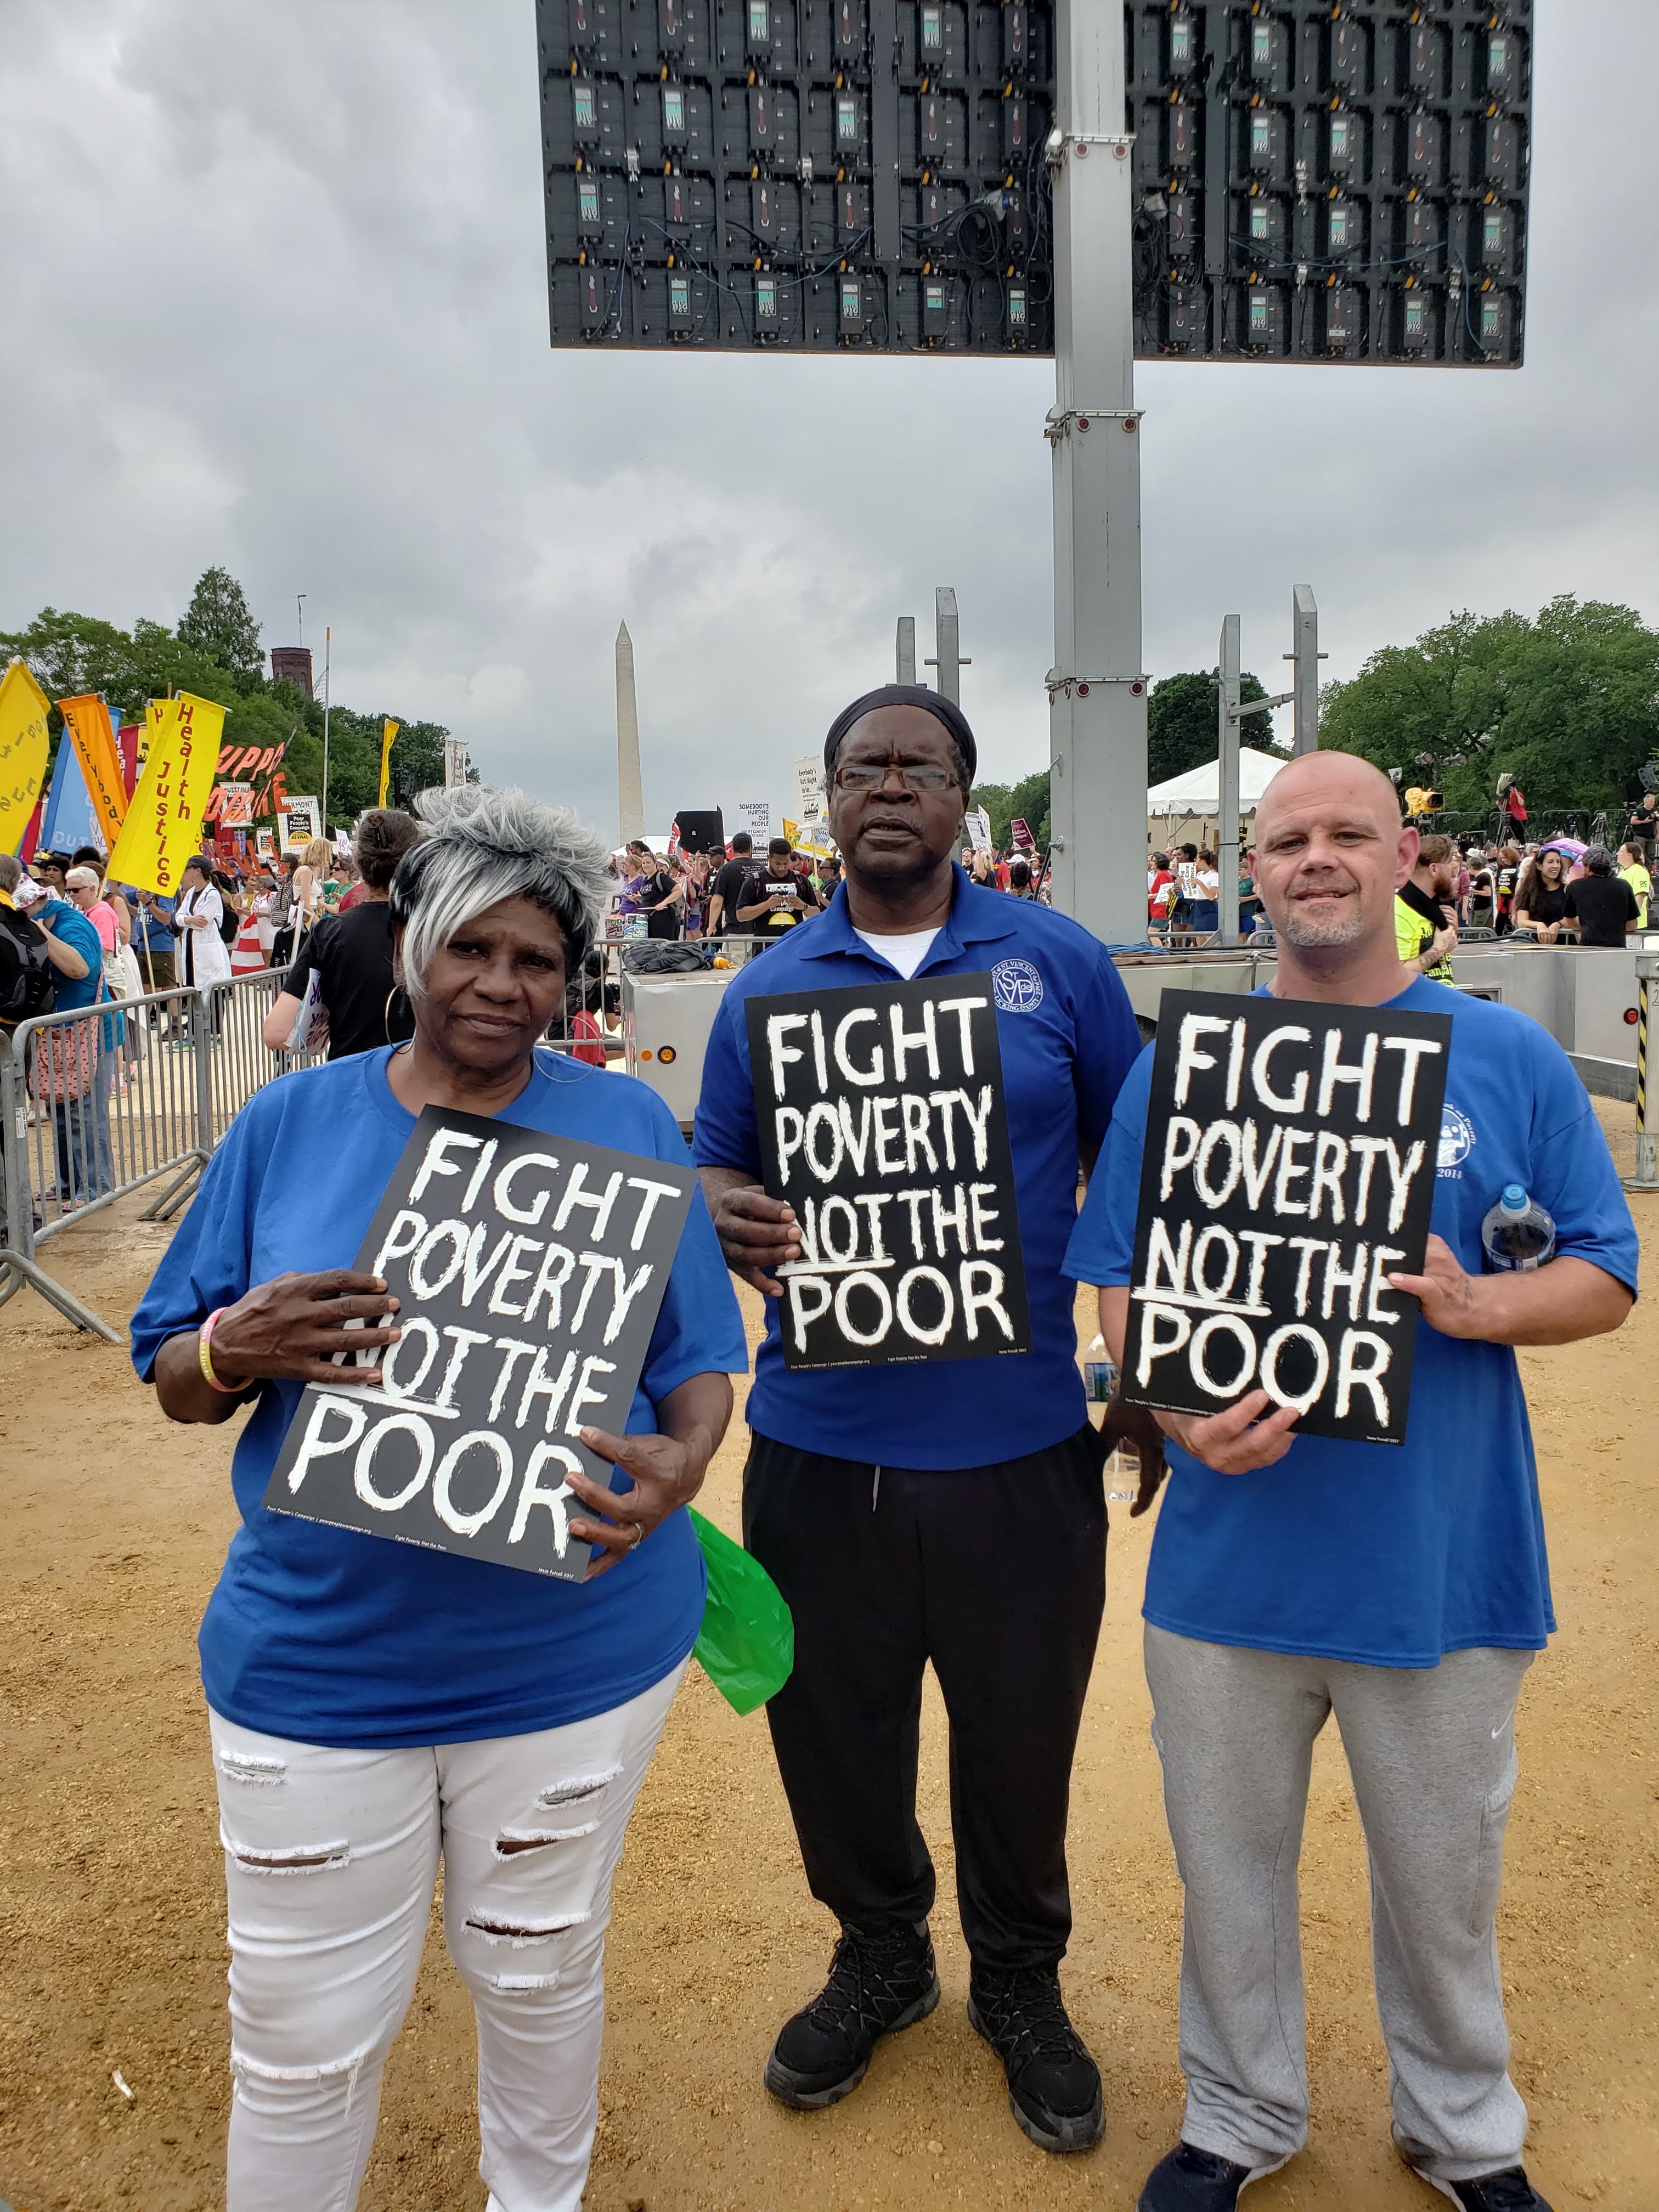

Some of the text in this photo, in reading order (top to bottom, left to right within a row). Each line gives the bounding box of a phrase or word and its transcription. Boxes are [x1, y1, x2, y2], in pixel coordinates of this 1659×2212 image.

[177, 703, 194, 820] Health
[156, 761, 171, 888] Justice
[995, 995, 1019, 1011] LICKING
[1010, 961, 1035, 975] VINCENT
[767, 997, 988, 1102] FIGHT
[1174, 1012, 1443, 1126] FIGHT
[775, 1085, 994, 1186] POVERTY
[1160, 1115, 1427, 1235] POVERTY
[1437, 1168, 1463, 1180] 2014
[1463, 1118, 1477, 1144] Poverty
[408, 1126, 682, 1251] FIGHT
[783, 1181, 1005, 1264] NOT THE
[371, 1209, 656, 1346] POVERTY
[788, 1260, 1015, 1354] POOR
[1143, 1216, 1407, 1324] NOT THE
[488, 1336, 618, 1437] THE
[1136, 1301, 1395, 1427] POOR
[277, 1508, 294, 1517] People's
[295, 1511, 315, 1521] Campaign
[319, 1517, 371, 1534] poorpeoplescampaign.org
[287, 1394, 586, 1560] POOR
[405, 1537, 420, 1546] Poverty
